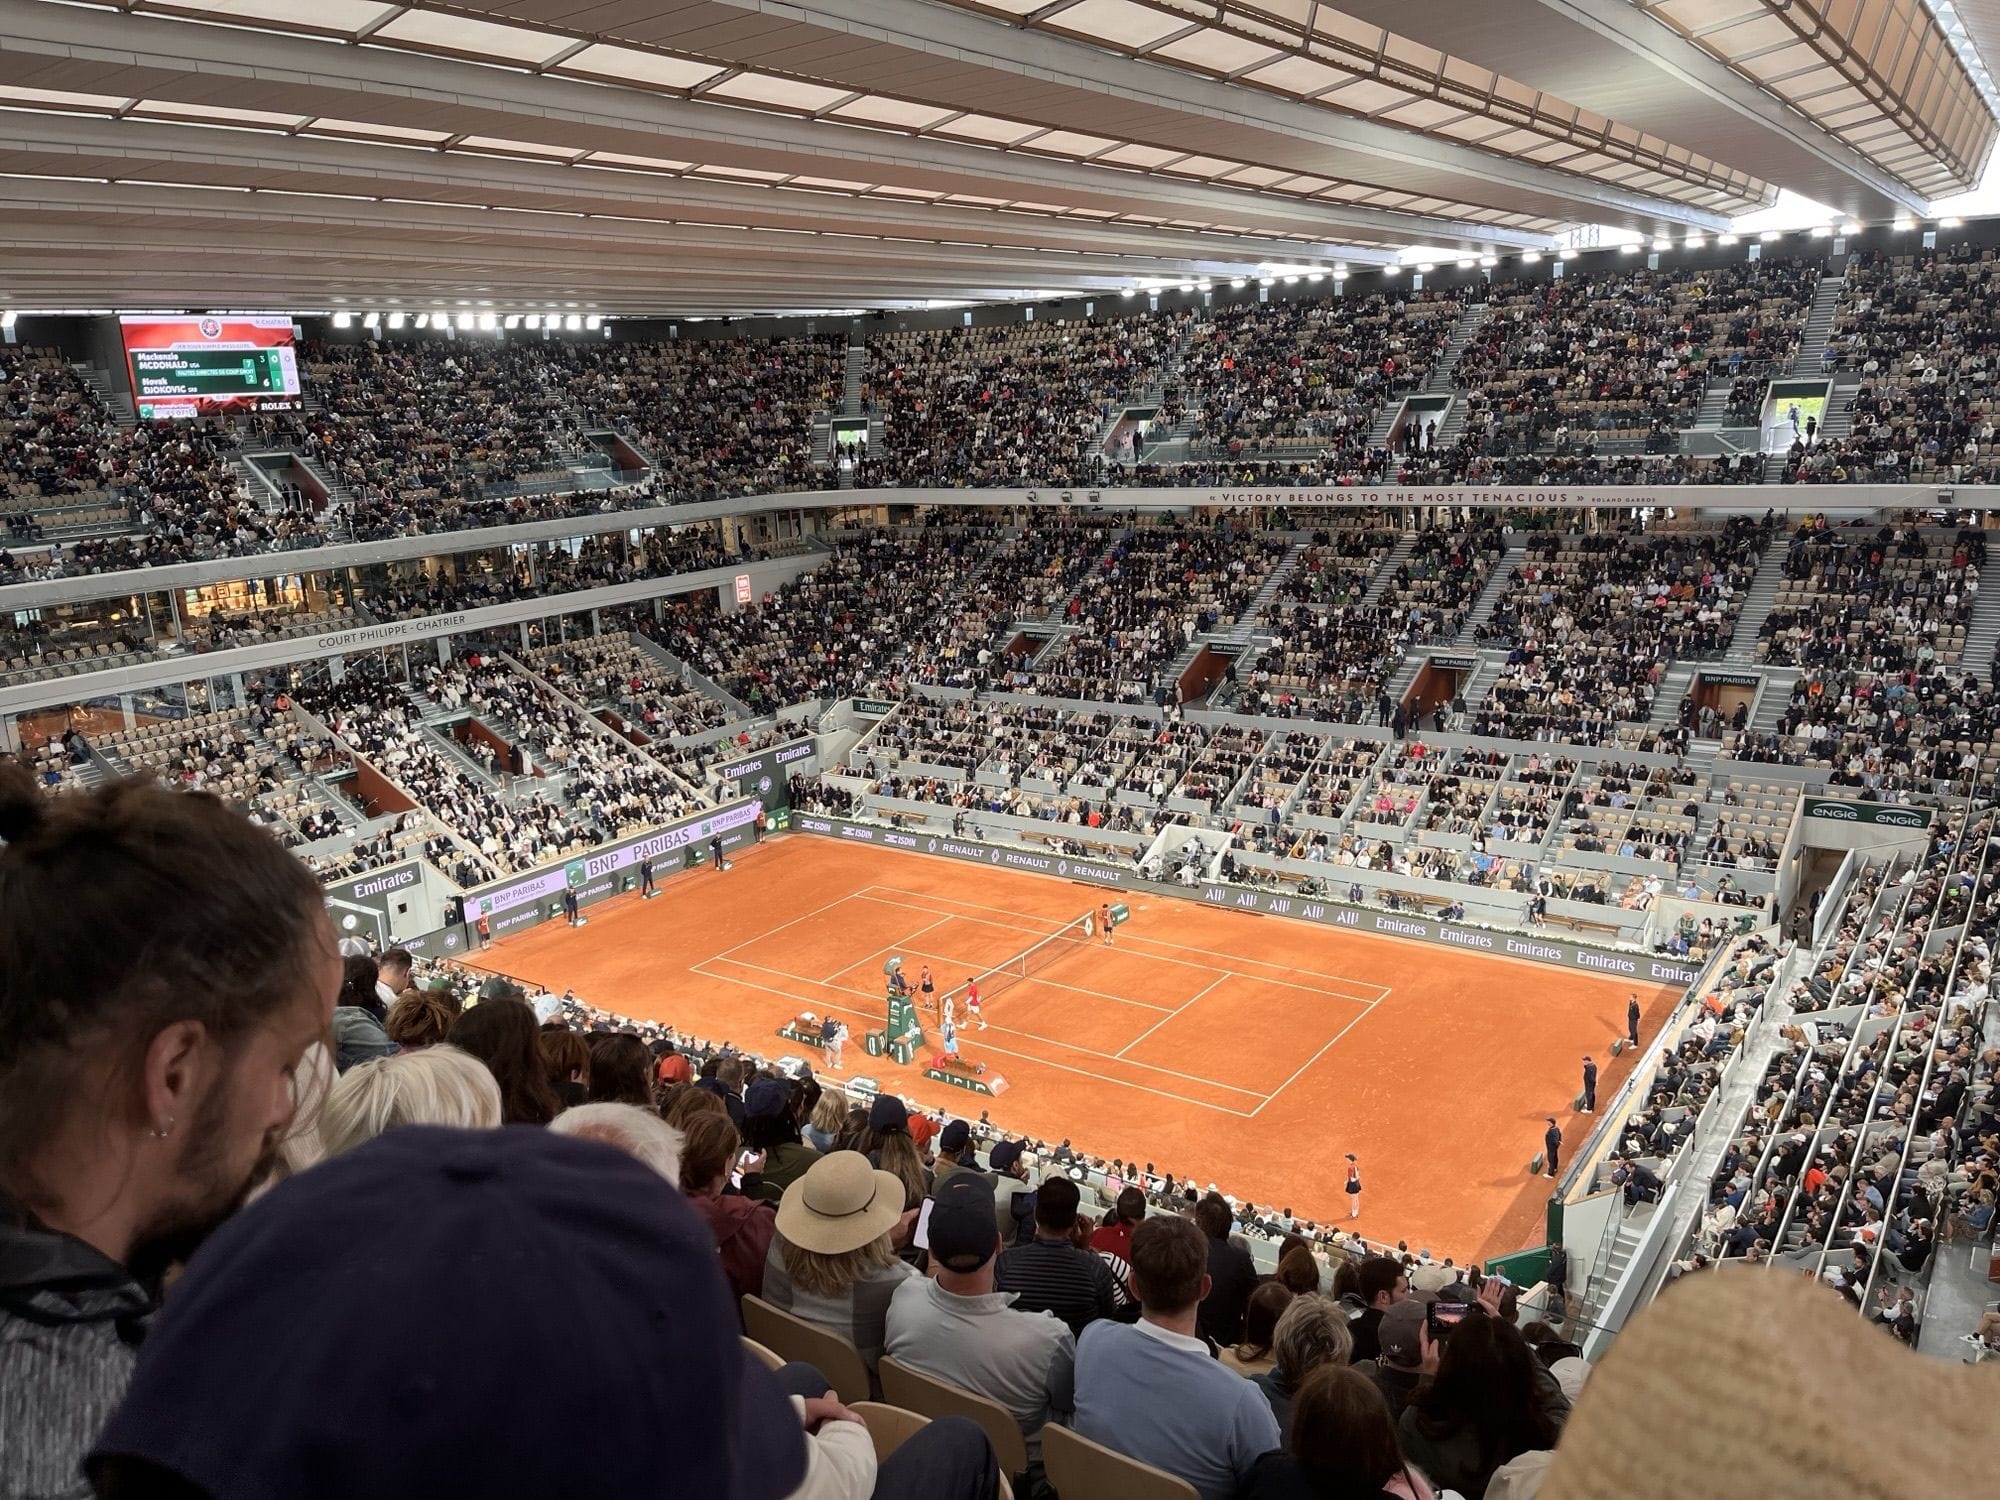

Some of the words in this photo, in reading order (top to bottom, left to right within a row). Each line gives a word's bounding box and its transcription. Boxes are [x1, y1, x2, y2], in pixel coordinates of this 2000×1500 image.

[138, 352, 179, 360] Mackenzie
[139, 361, 188, 369] MCDONALD
[142, 377, 168, 385] Novak
[143, 385, 187, 394] DJOKOVIC
[263, 378, 270, 386] 6
[261, 402, 292, 410] ROLEX
[1222, 493, 1282, 502] VICTORY
[1289, 493, 1353, 502] BELONGS
[1361, 493, 1379, 501] TO
[1387, 493, 1414, 501] THE
[1423, 493, 1464, 502] MOST
[1472, 493, 1568, 502] TENACIOUS
[318, 633, 357, 649] COURT
[360, 625, 407, 641] PHILIPPE
[416, 615, 466, 631] CHATRIER
[1722, 676, 1756, 684] PARIBAS
[776, 743, 811, 764] Emirates
[724, 759, 762, 779] Emirates
[814, 820, 831, 833] ISDIN
[854, 827, 873, 839] ISDIN
[898, 835, 917, 847] ISDIN
[589, 853, 619, 877] BNP
[633, 828, 690, 861] PARIBAS
[942, 843, 985, 858] RENAULT
[1006, 854, 1050, 869] RENAULT
[1073, 865, 1121, 881] RENAULT
[354, 870, 414, 898] Emirates
[494, 892, 511, 904] BNP
[512, 880, 546, 898] PARIBAS
[496, 919, 511, 930] BNP
[511, 908, 539, 924] PARIBAS
[1376, 916, 1426, 936] Emirates
[1439, 927, 1493, 948] Emirates
[1506, 939, 1562, 960] Emirates
[1576, 951, 1636, 972] Emirates
